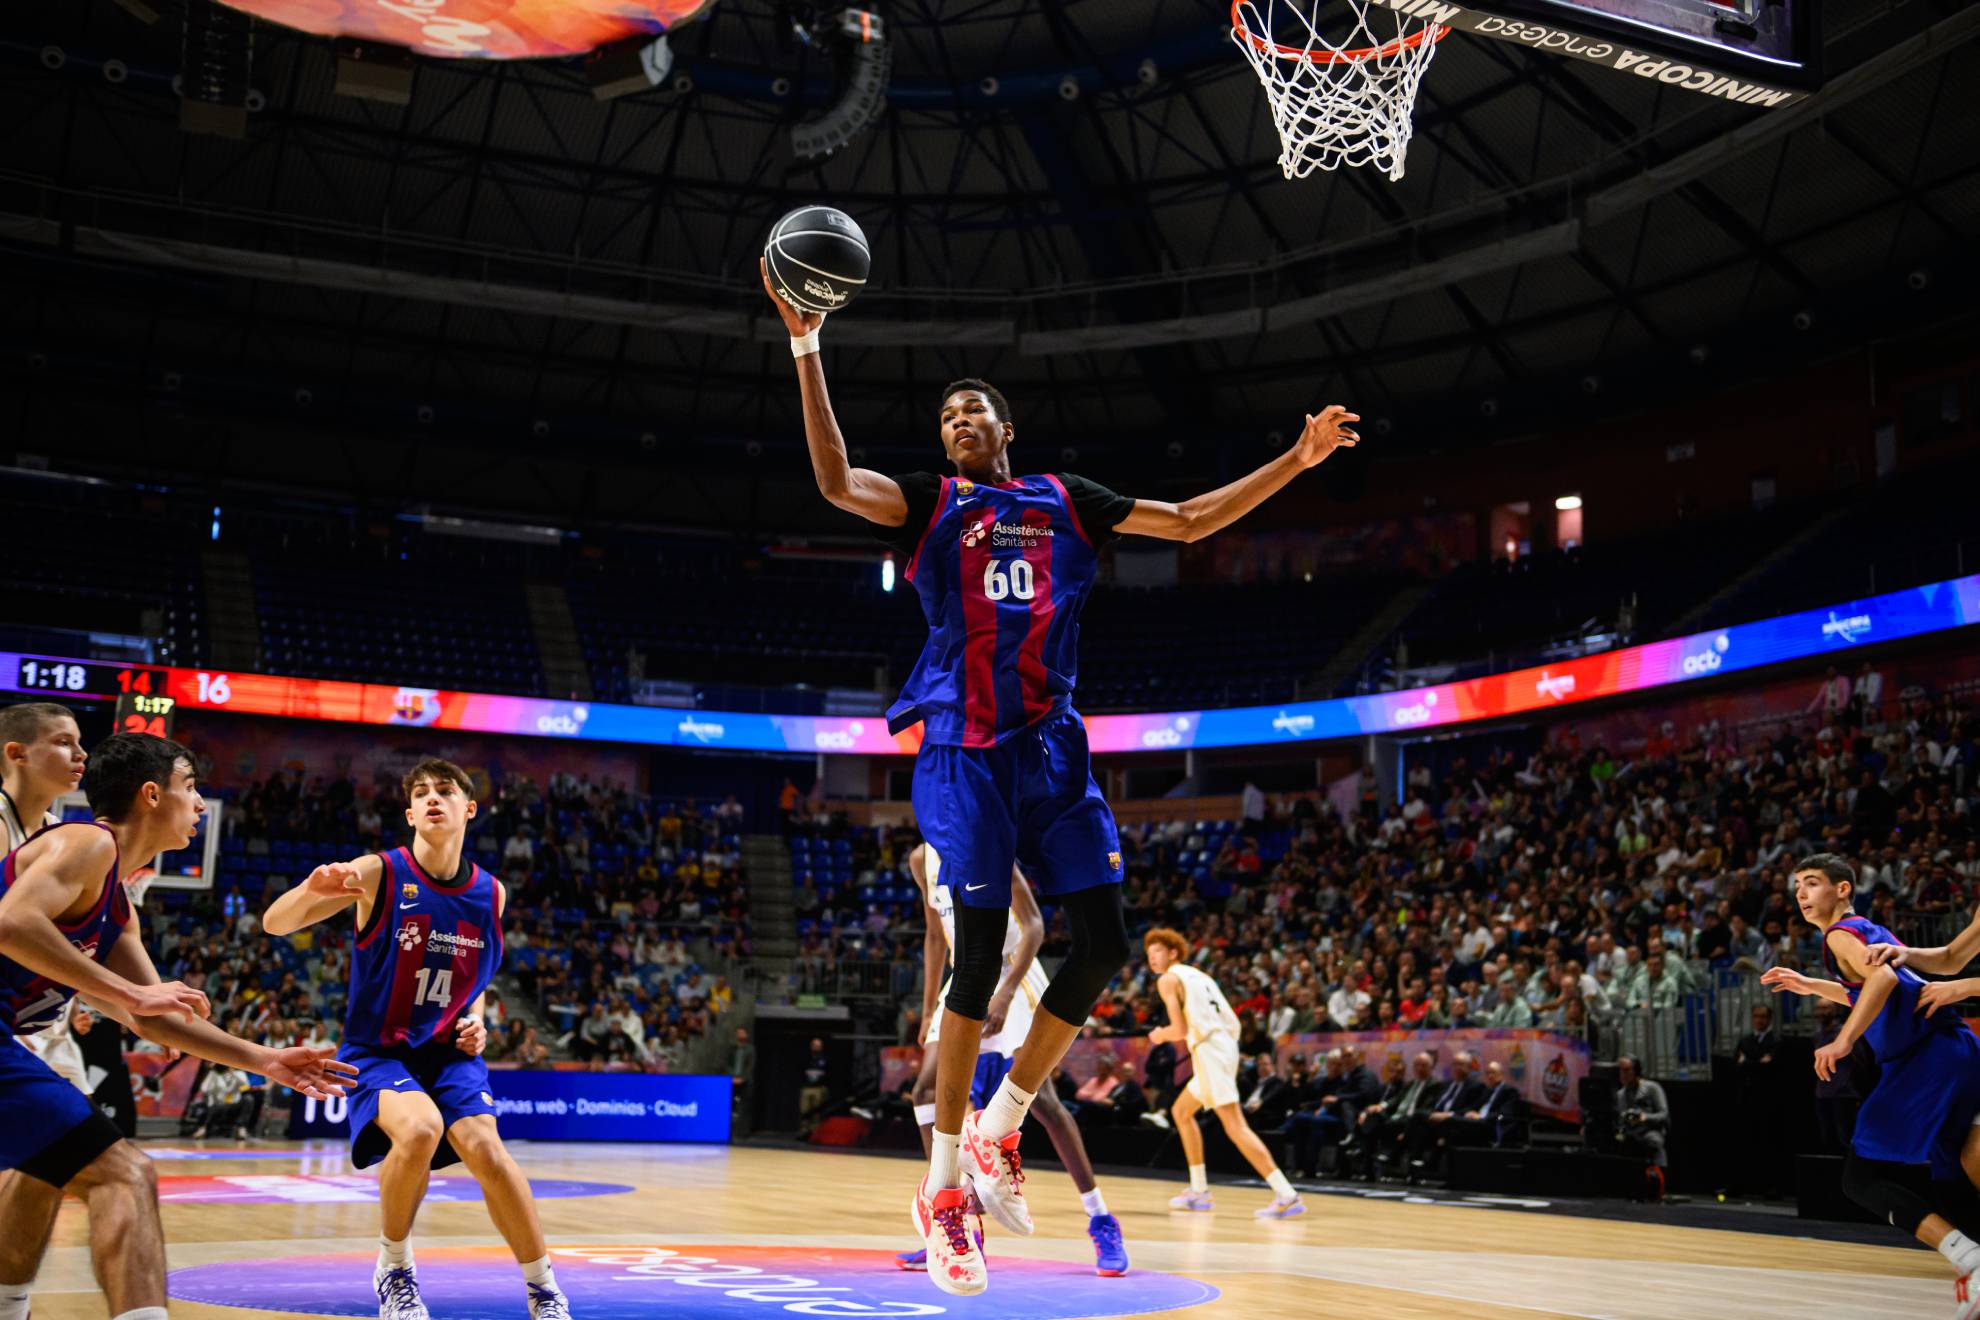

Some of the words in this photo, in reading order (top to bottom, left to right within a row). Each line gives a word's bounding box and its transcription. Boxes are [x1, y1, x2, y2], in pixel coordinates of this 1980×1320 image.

[1474, 16, 1613, 59] endesa
[1613, 50, 1791, 108] MINICOPA
[993, 521, 1054, 537] Assistència
[993, 533, 1037, 547] Sanitària
[984, 560, 1035, 600] 60
[22, 662, 87, 690] 1:18
[117, 670, 151, 694] 14
[197, 673, 231, 704] 16
[134, 695, 174, 714] 1:17
[124, 714, 166, 738] 24
[426, 941, 467, 957] Sanitària
[428, 929, 485, 949] Assistència
[414, 967, 453, 1008] 14
[536, 1099, 567, 1115] web
[575, 1098, 646, 1116] Dominios
[654, 1099, 698, 1117] Cloud
